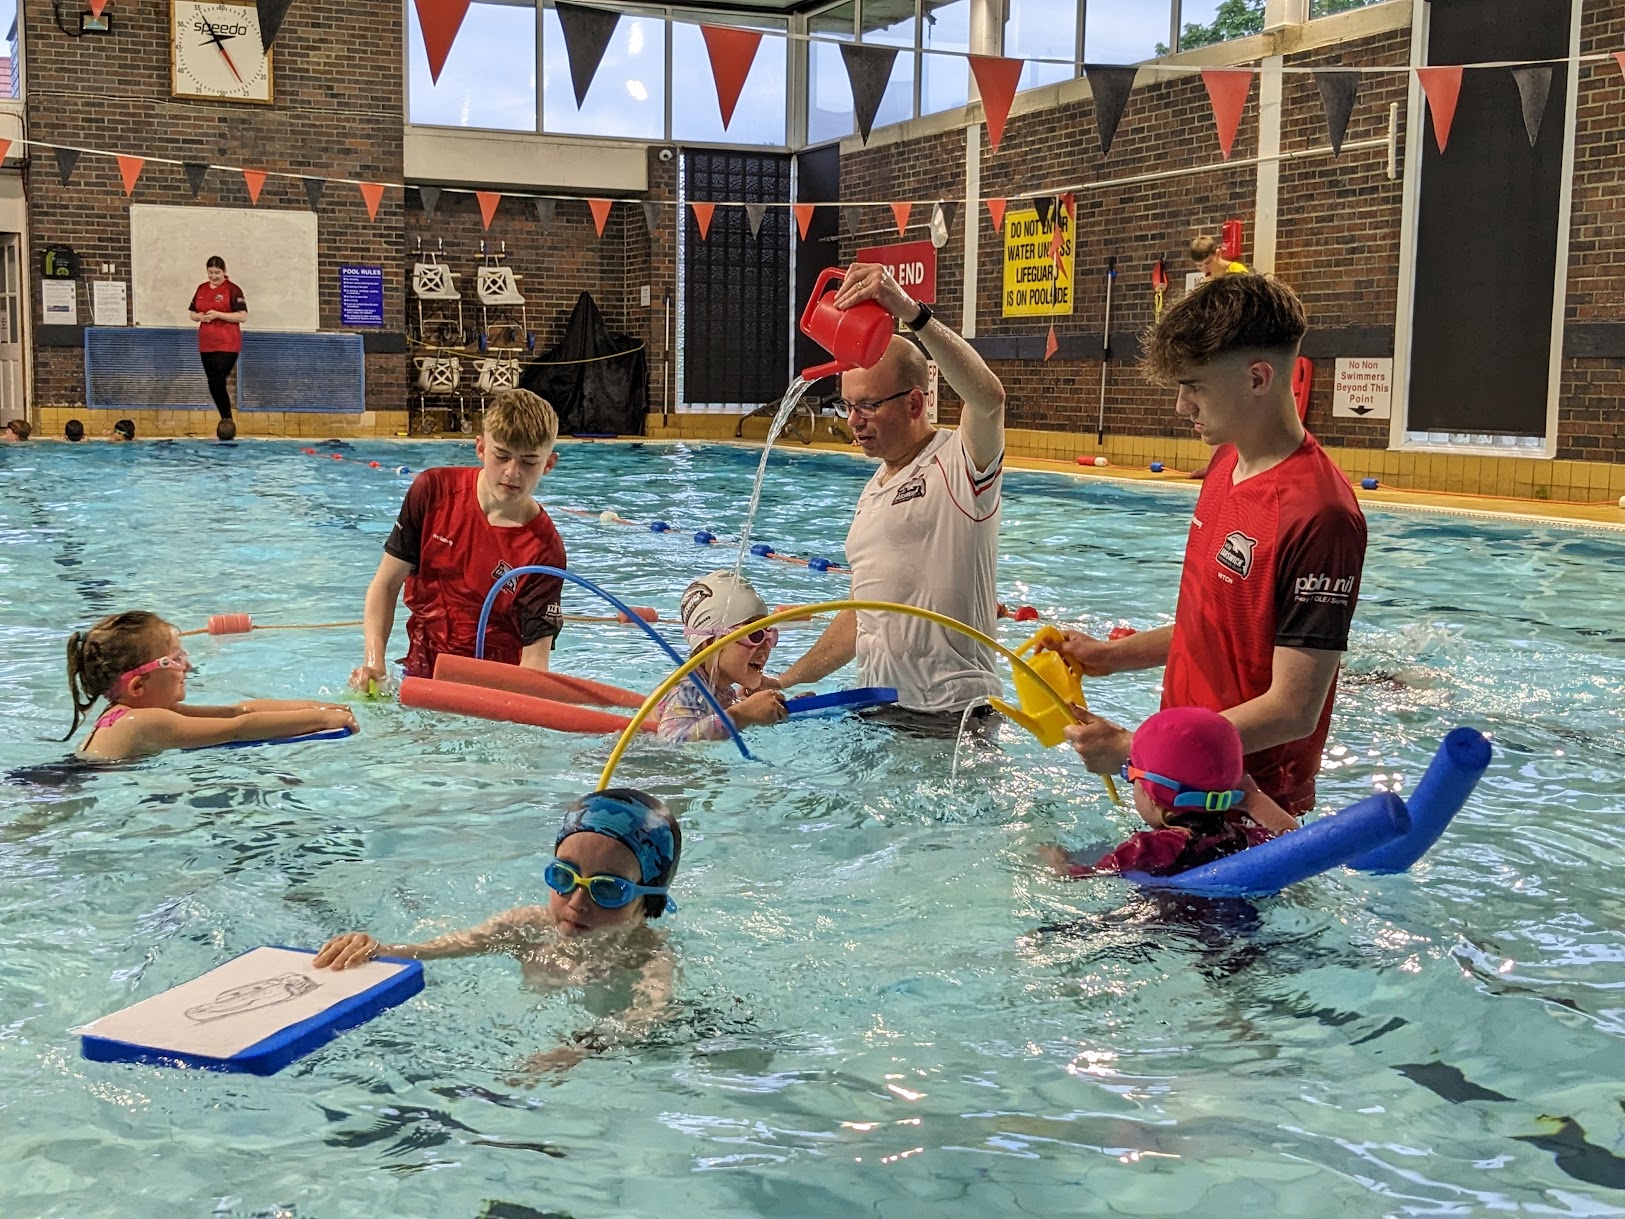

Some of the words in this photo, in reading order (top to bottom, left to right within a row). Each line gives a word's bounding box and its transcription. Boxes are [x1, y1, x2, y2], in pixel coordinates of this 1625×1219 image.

[194, 22, 247, 35] speedo
[1010, 222, 1022, 238] DO
[1024, 220, 1040, 237] NOT
[1008, 243, 1035, 261] WATER
[1038, 239, 1071, 258] UNSS
[899, 262, 924, 286] END
[1007, 290, 1014, 306] IS
[1016, 289, 1027, 306] ON
[1349, 360, 1360, 369] No
[1362, 360, 1378, 369] Non
[1341, 371, 1385, 381] Swimmers
[1336, 383, 1367, 393] Beyond
[1370, 383, 1389, 392] This
[1350, 394, 1374, 403] Point
[1294, 573, 1331, 594] pbh
